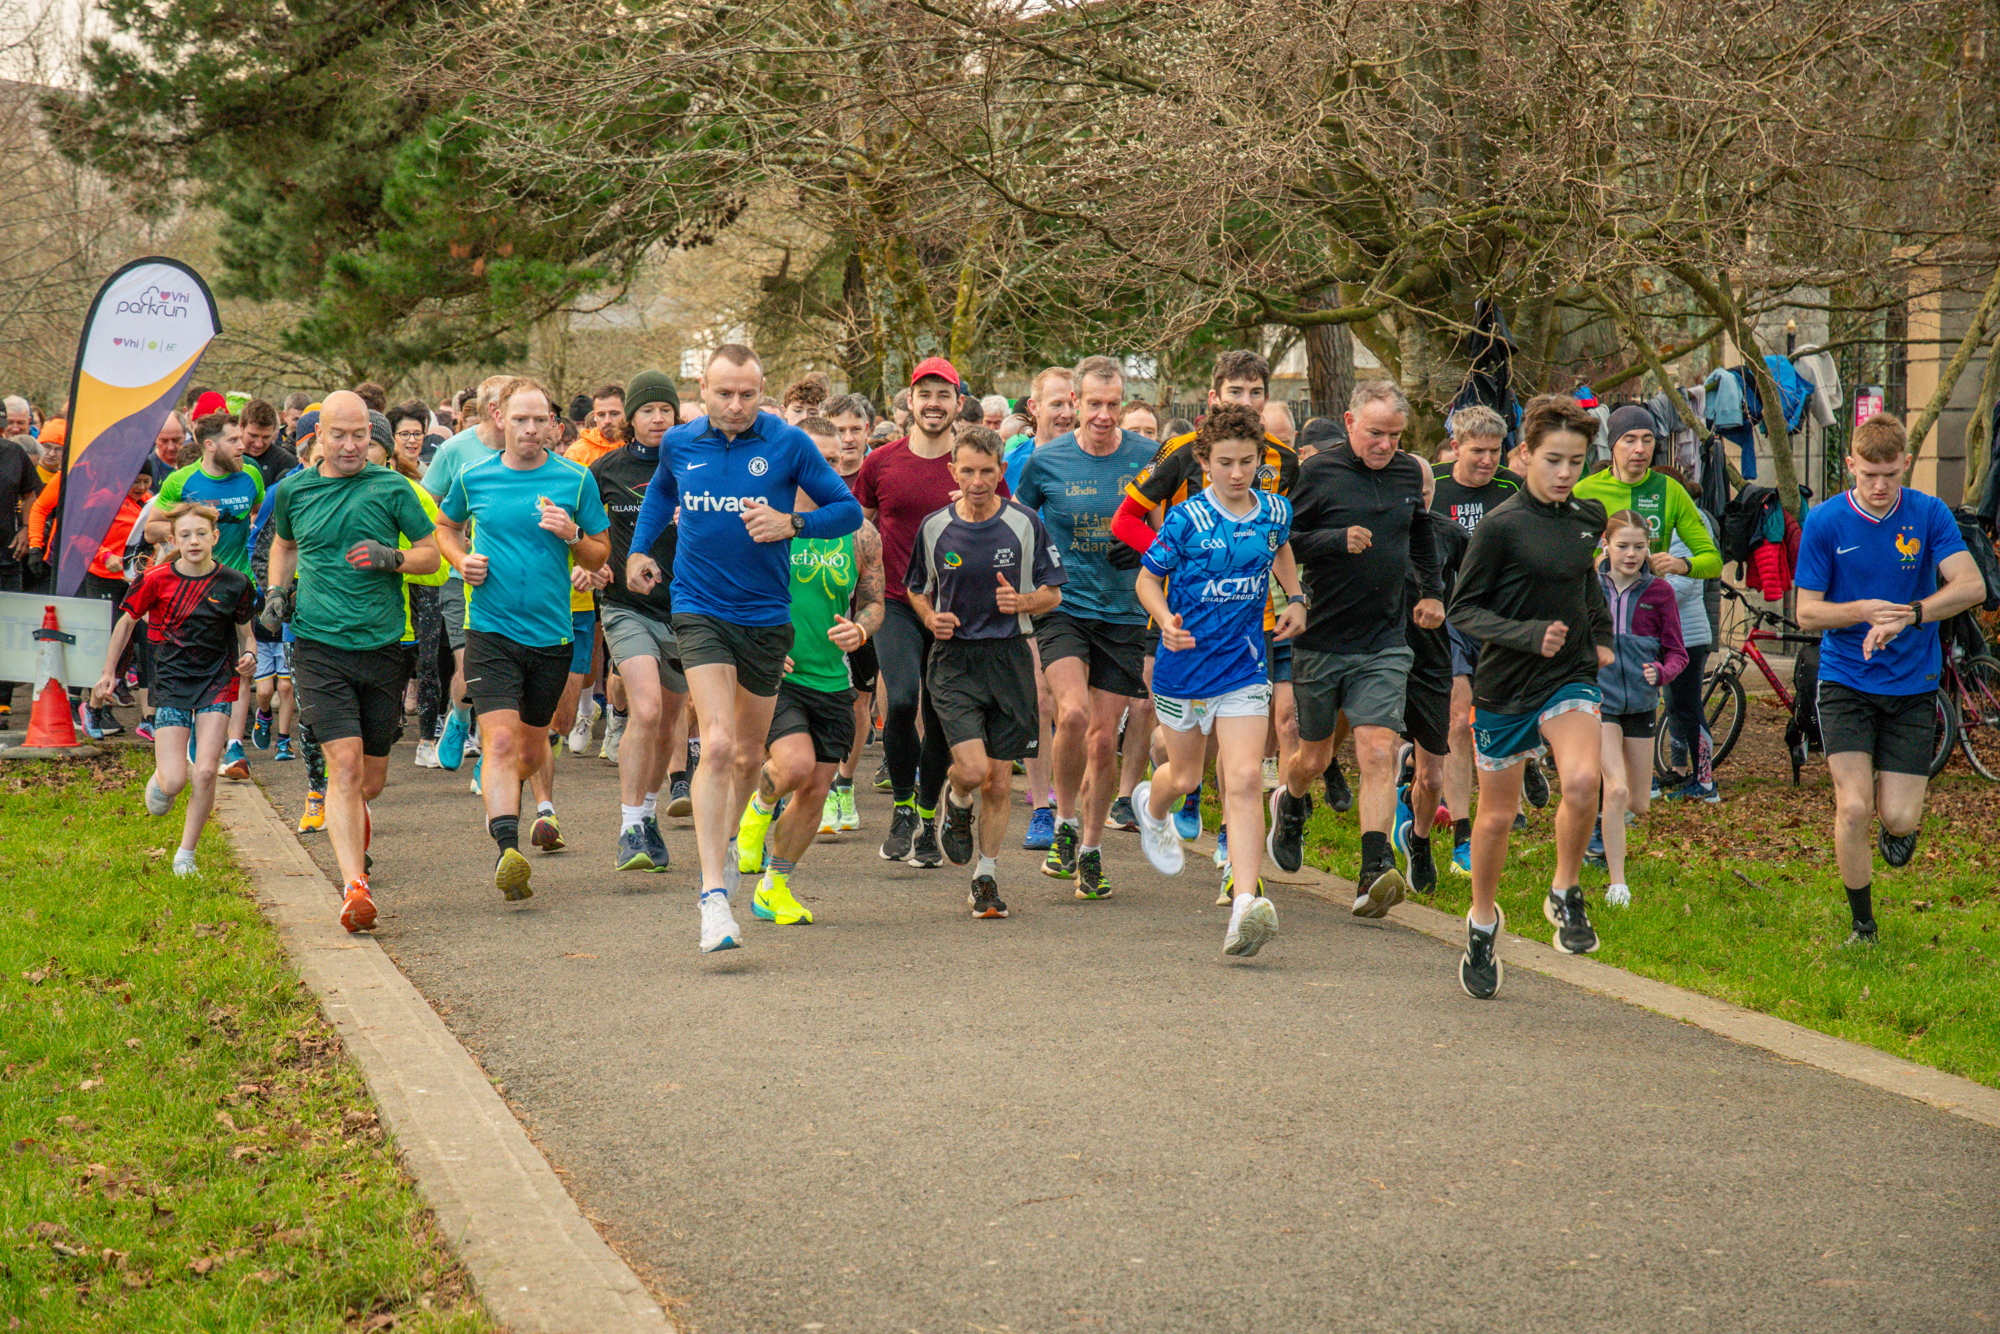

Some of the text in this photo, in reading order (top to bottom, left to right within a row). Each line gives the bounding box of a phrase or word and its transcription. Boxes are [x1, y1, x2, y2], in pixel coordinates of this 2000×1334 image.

[171, 291, 190, 304] Vhi
[115, 293, 188, 318] parkrun
[123, 338, 140, 348] Vhi
[1065, 486, 1098, 497] Londis
[220, 495, 249, 505] TRIATHLON
[611, 505, 642, 513] KILLARN
[1451, 502, 1483, 516] URBAN
[1233, 528, 1257, 538] oneills
[1069, 538, 1114, 552] Adare
